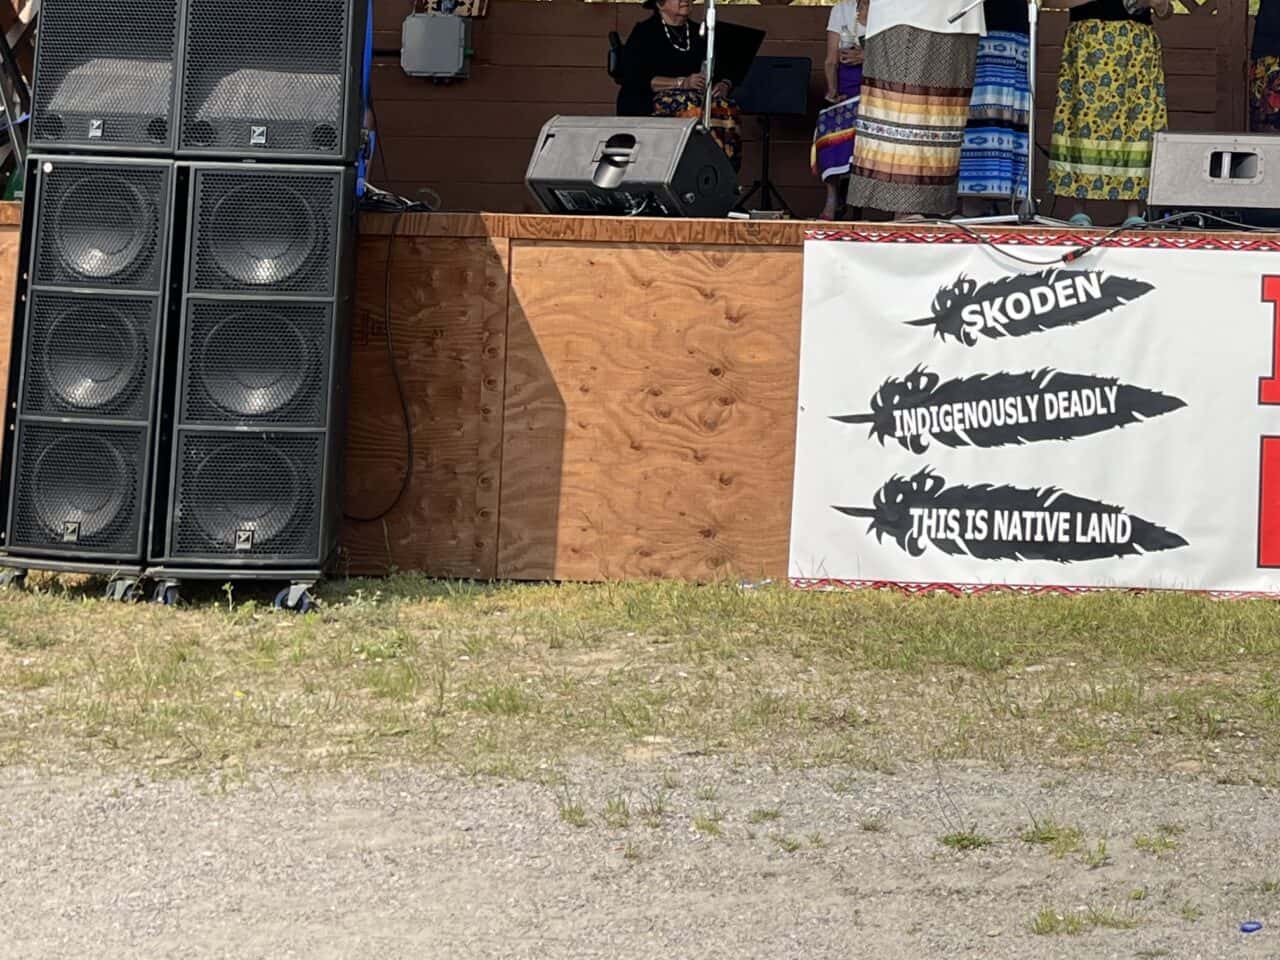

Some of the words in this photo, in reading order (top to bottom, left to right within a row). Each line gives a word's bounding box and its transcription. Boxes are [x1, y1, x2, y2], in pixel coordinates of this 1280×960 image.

[961, 273, 1102, 332] SKODEN
[893, 395, 1039, 438] INDIGENOUSLY
[1044, 386, 1118, 420] DEADLY
[909, 508, 960, 540] THIS
[964, 508, 988, 541] IS
[993, 510, 1071, 543] NATIVE
[1075, 512, 1133, 545] LAND
